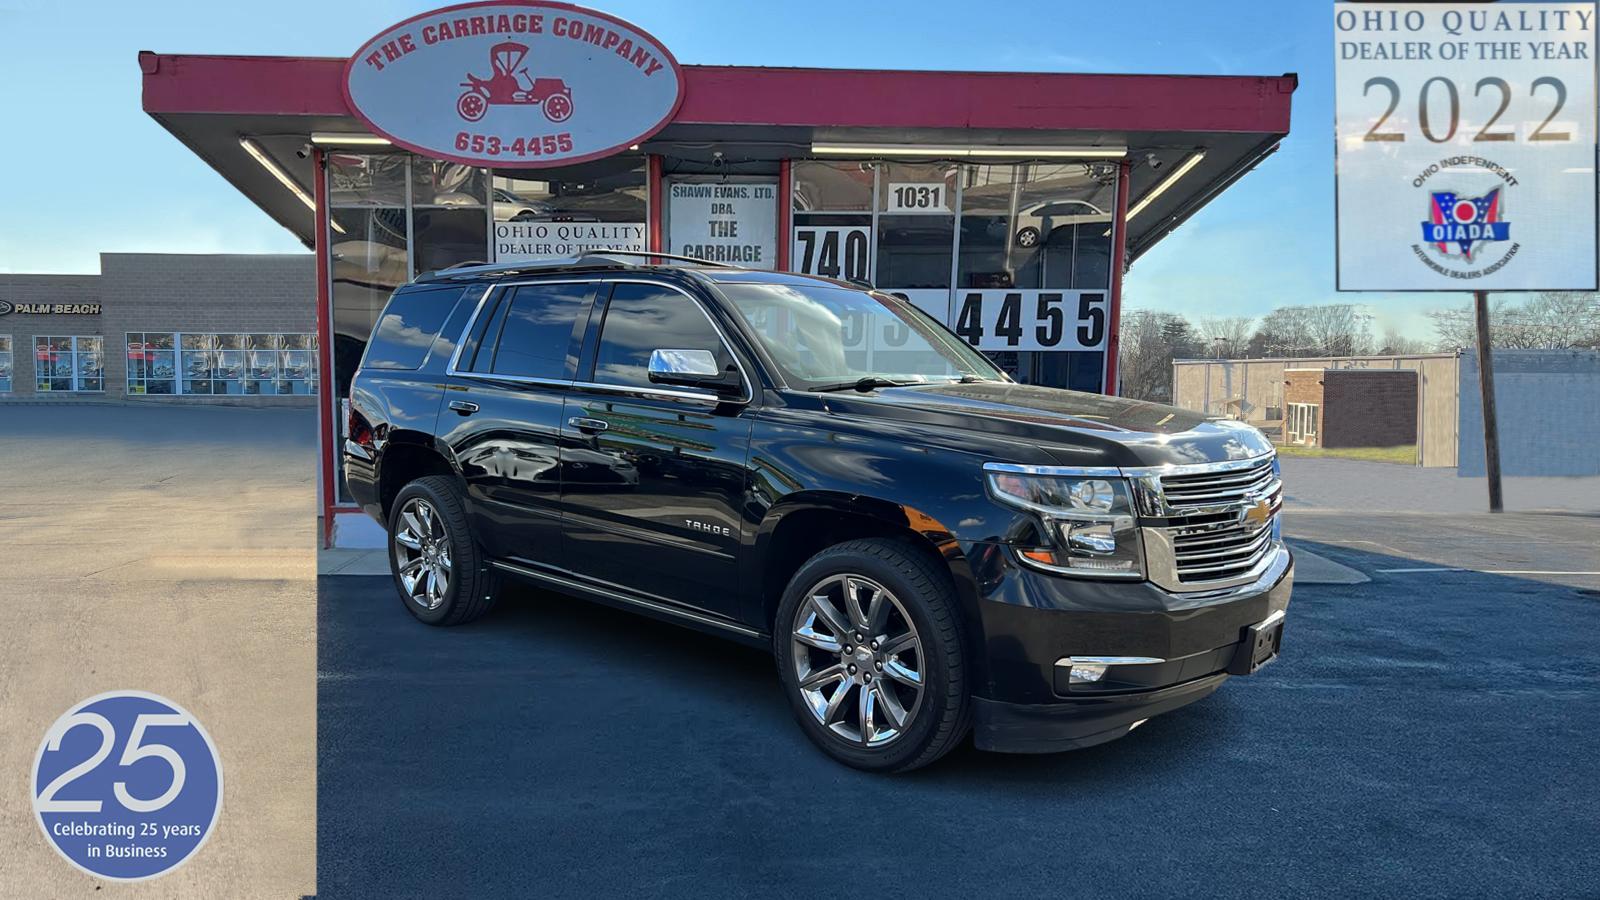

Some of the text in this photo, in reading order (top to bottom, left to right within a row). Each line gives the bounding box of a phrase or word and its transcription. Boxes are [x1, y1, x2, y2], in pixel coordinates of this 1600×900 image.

[1336, 10, 1592, 36] OHIO QUALITY
[366, 14, 664, 77] THE CARRIAGE COMPANY
[1340, 42, 1589, 60] DEALER OF THE YEAR
[1363, 76, 1571, 143] 2022
[454, 132, 573, 156] 653-4455
[1412, 156, 1519, 188] OHIO INDEPENDENT
[673, 186, 712, 198] SHAWN
[754, 188, 775, 199] LTD.
[894, 187, 940, 208] 1031
[711, 203, 736, 215] DBA.
[497, 226, 644, 240] OHIO QUALITY
[708, 221, 738, 238] THE
[1432, 224, 1495, 240] OIADA
[500, 243, 552, 254] DEALER
[555, 244, 573, 254] OF
[683, 244, 762, 262] CARRIAGE
[798, 230, 867, 282] 740
[1411, 242, 1521, 279] AUTOMOBILE DEALERS ASSOCIATION
[15, 304, 100, 314] PALM BEACH
[956, 293, 1105, 347] 4455
[685, 519, 730, 537] TAHOE
